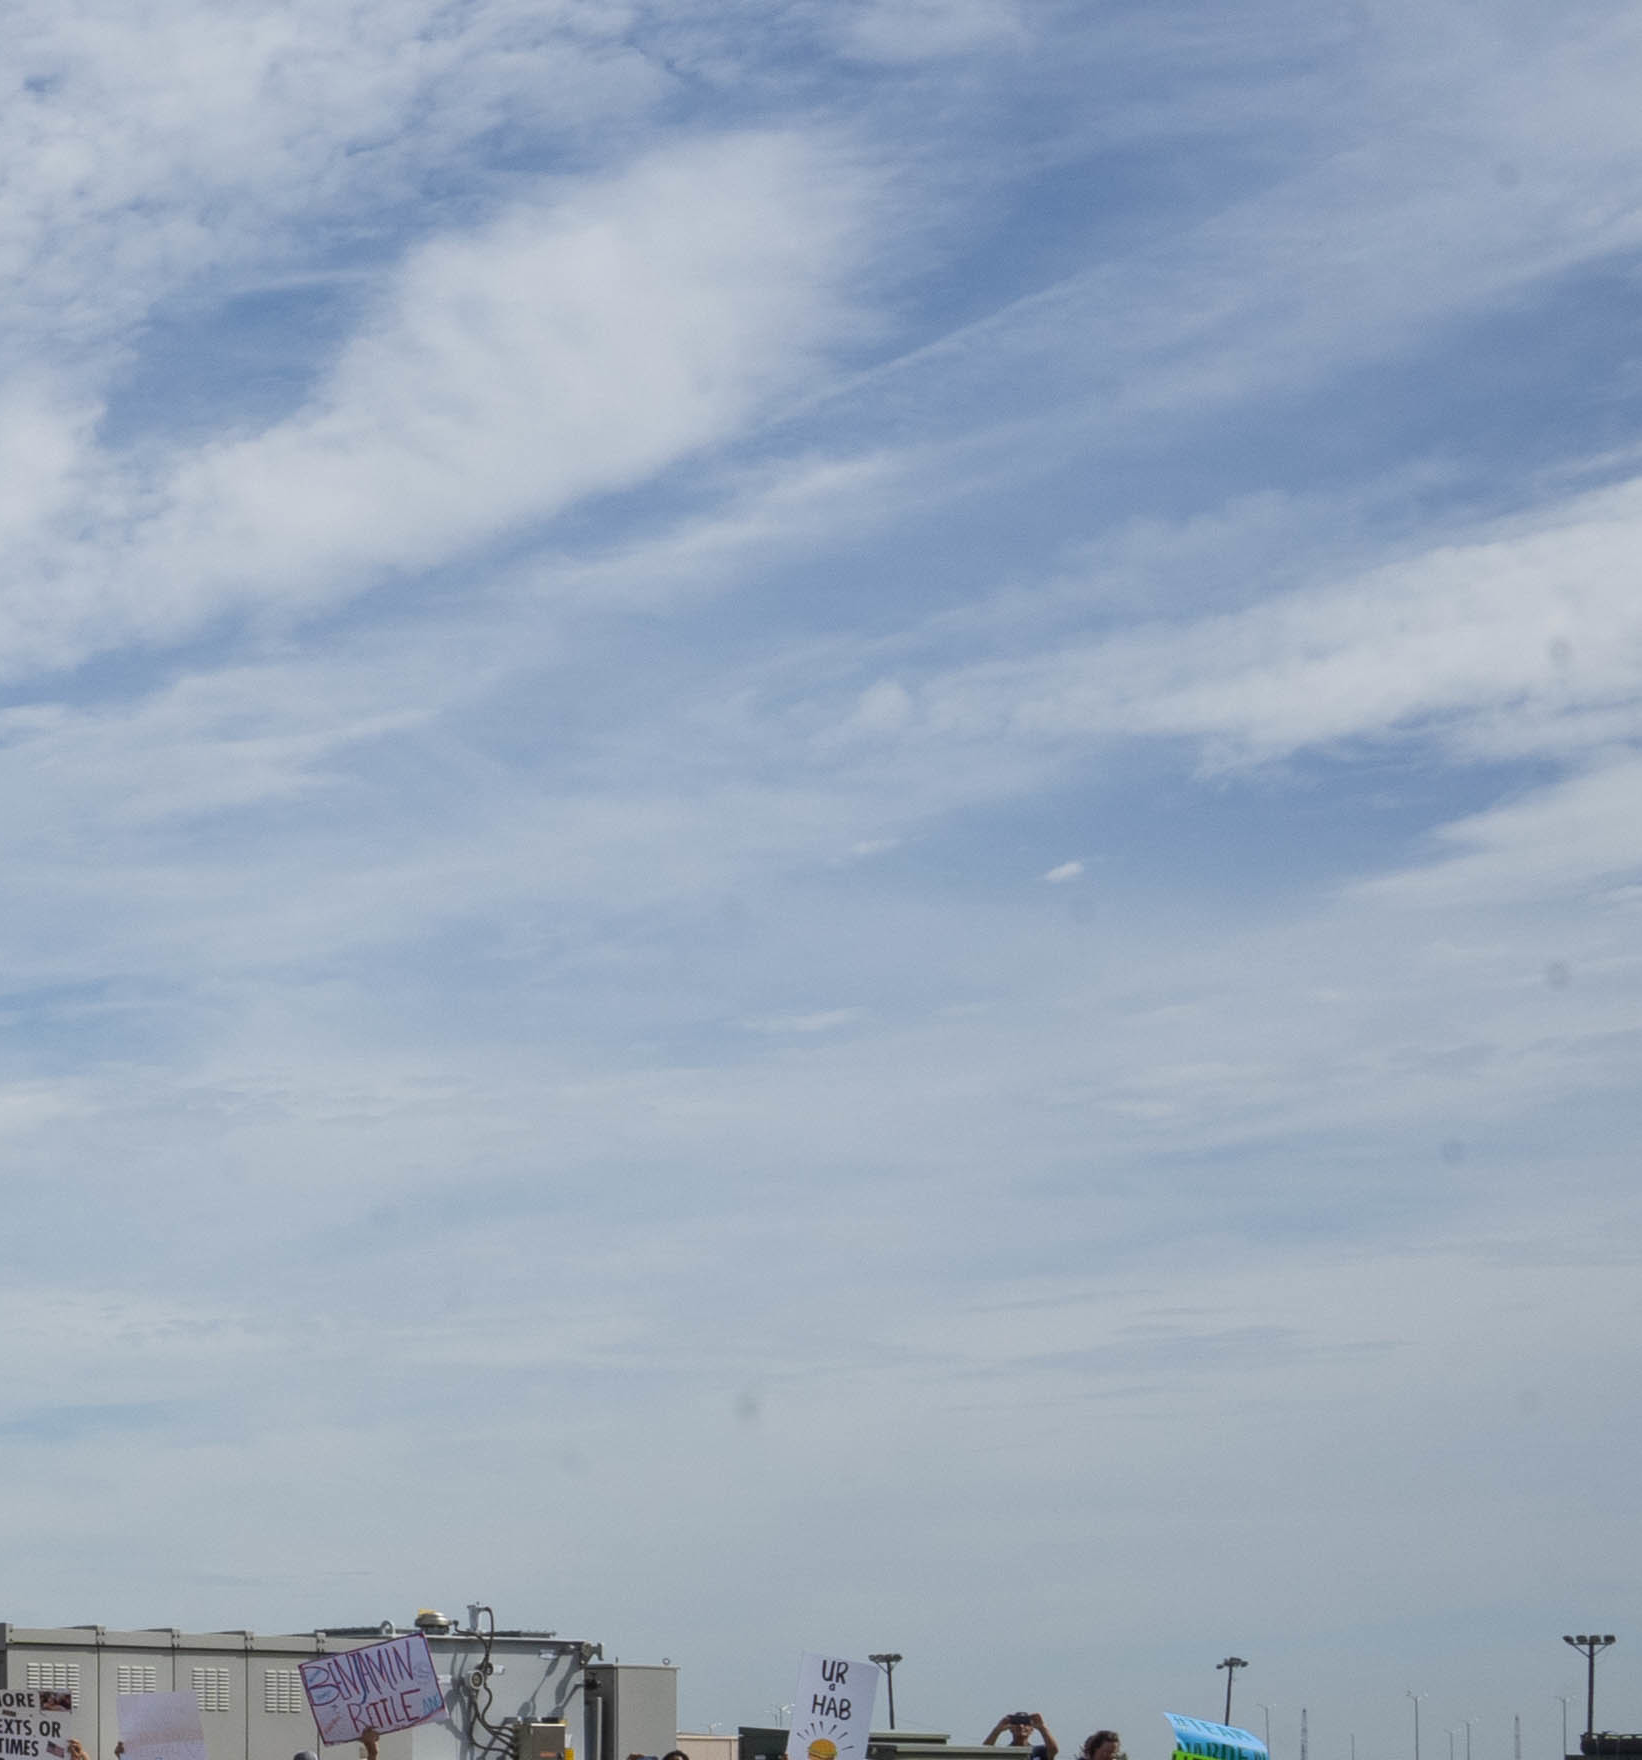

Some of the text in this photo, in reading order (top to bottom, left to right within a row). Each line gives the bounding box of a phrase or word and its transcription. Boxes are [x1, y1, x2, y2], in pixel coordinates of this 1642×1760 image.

[300, 1640, 414, 1707] BENJAMIN
[821, 1660, 849, 1685] UR
[811, 1693, 852, 1721] HAB
[39, 1720, 61, 1738] OR
